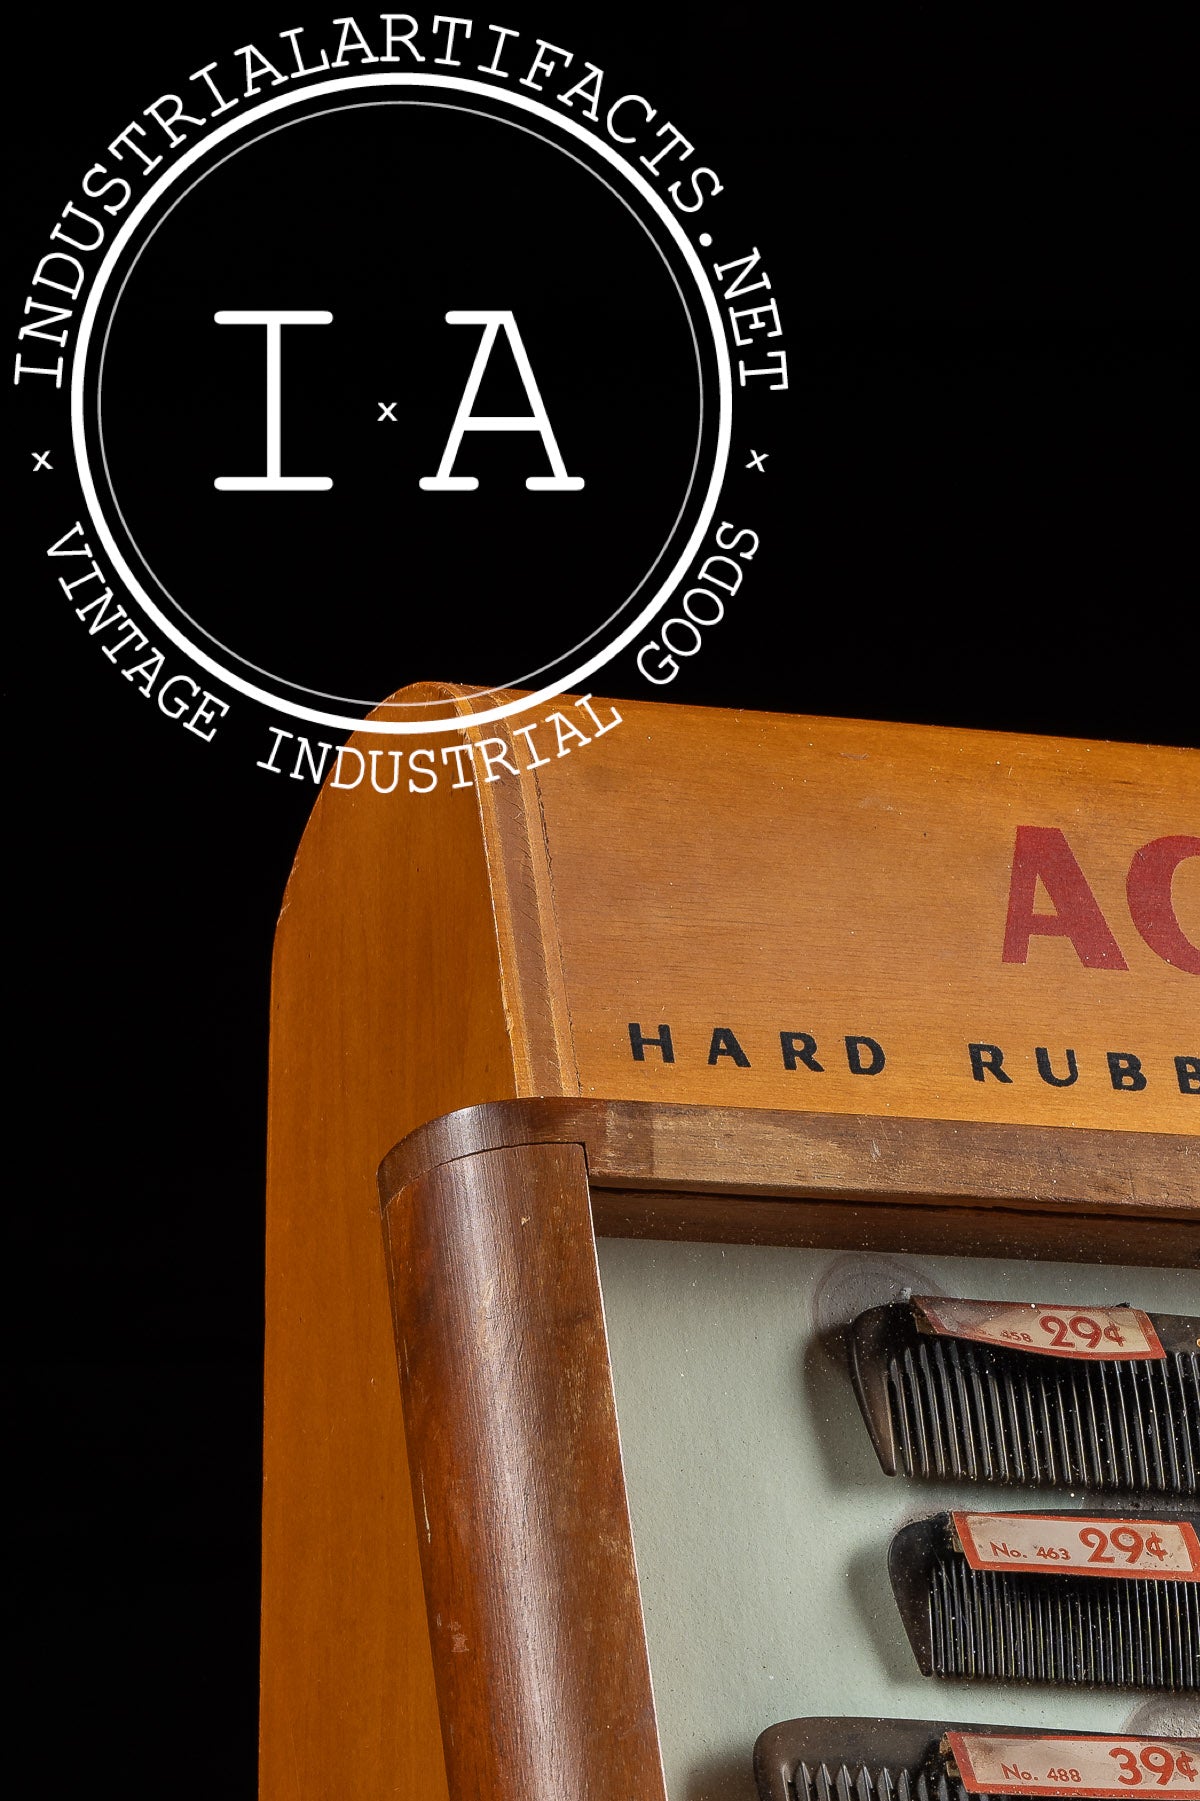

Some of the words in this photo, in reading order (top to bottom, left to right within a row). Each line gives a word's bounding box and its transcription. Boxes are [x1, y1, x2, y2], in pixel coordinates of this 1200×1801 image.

[628, 1021, 886, 1076] HARD
[990, 1541, 1027, 1561] No.
[1036, 1546, 1071, 1562] 463
[1079, 1526, 1168, 1565] 29¢
[1001, 1762, 1040, 1782] No.
[1046, 1767, 1082, 1784] 488
[1108, 1745, 1198, 1787] 39¢
